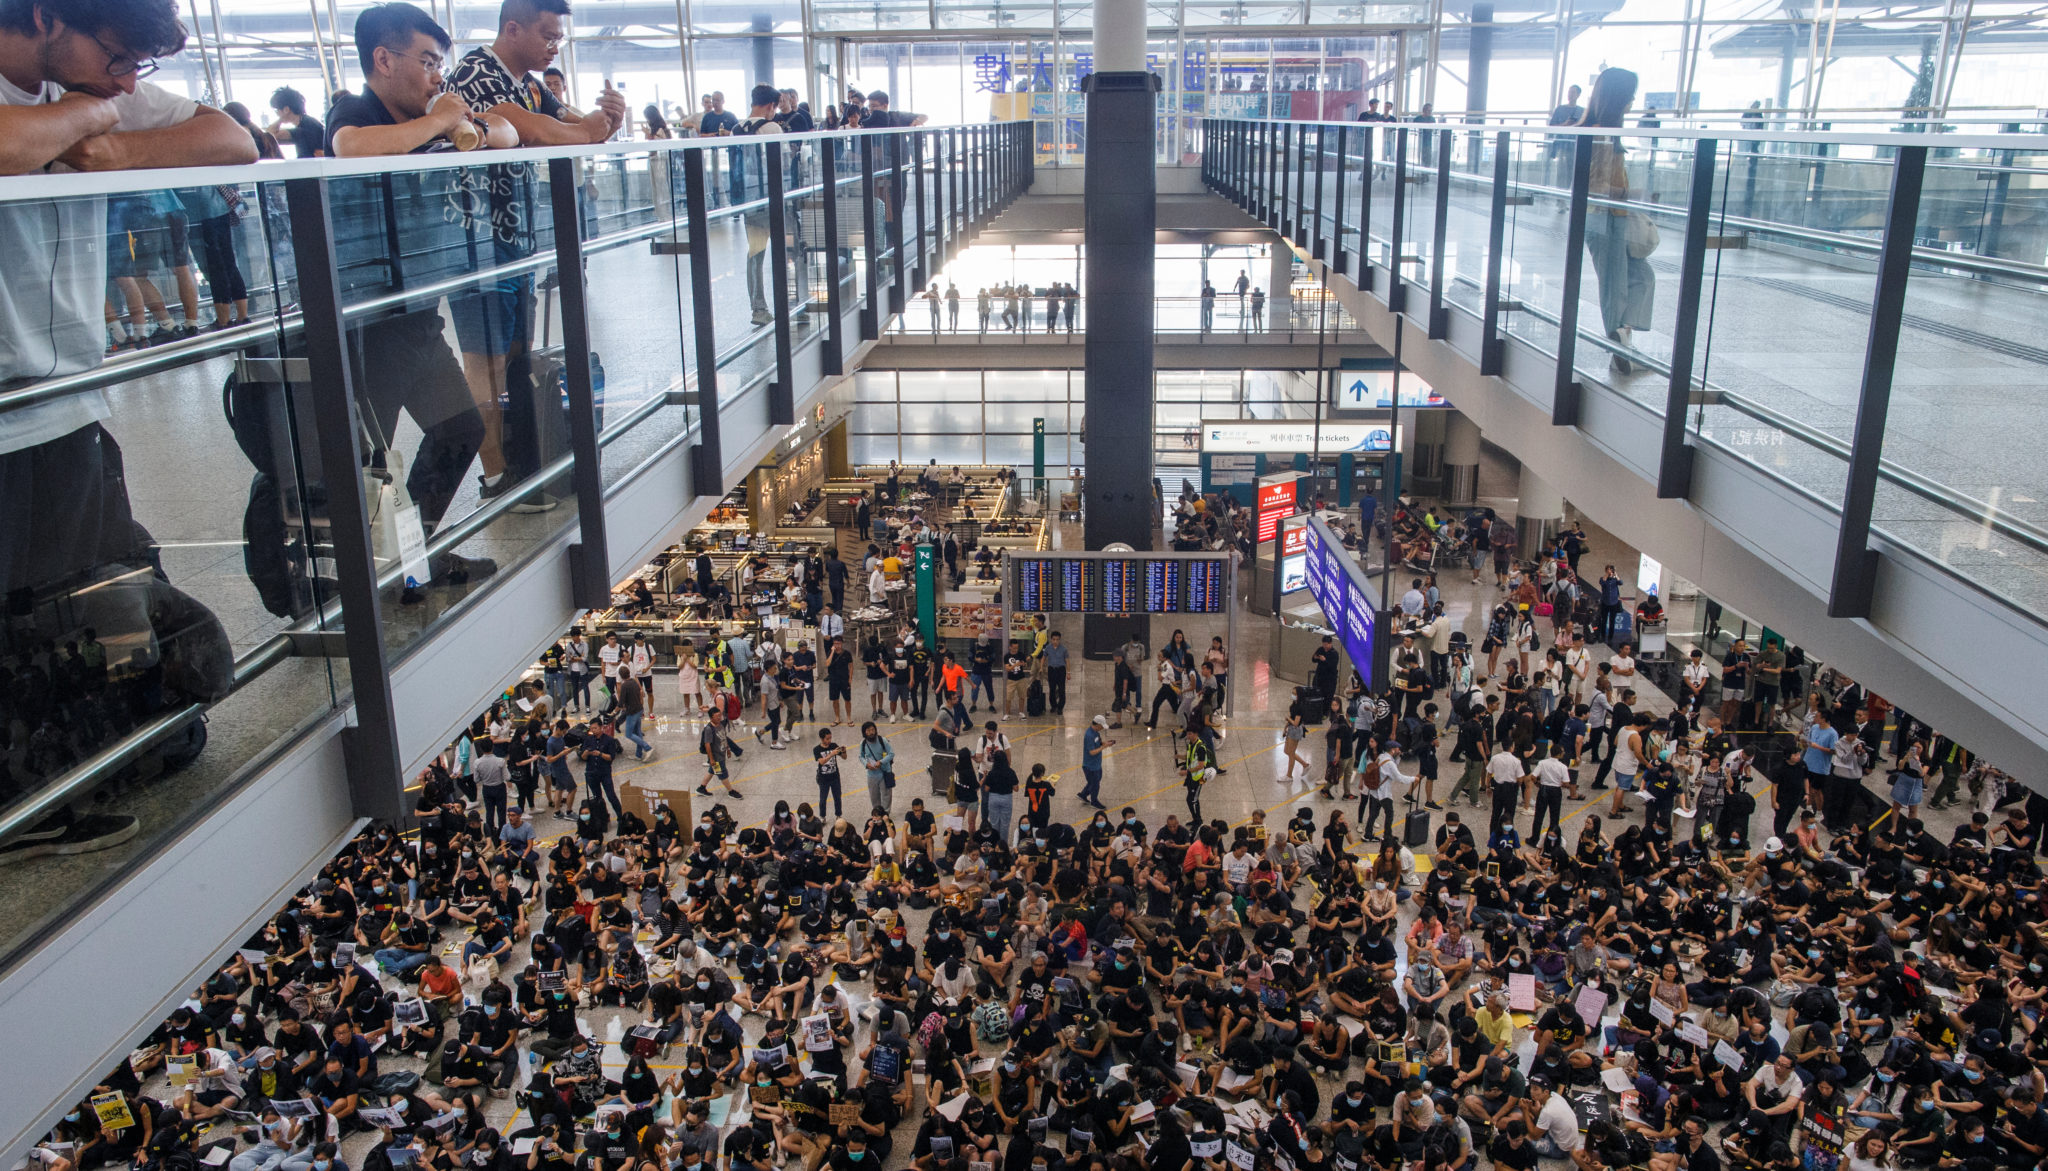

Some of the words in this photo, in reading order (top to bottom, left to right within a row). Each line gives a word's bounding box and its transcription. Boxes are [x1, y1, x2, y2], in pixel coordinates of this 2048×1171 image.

[1270, 433, 1303, 442] 列車車票
[1305, 434, 1324, 442] Trn
[1325, 434, 1350, 442] tickets
[1027, 788, 1047, 813] V
